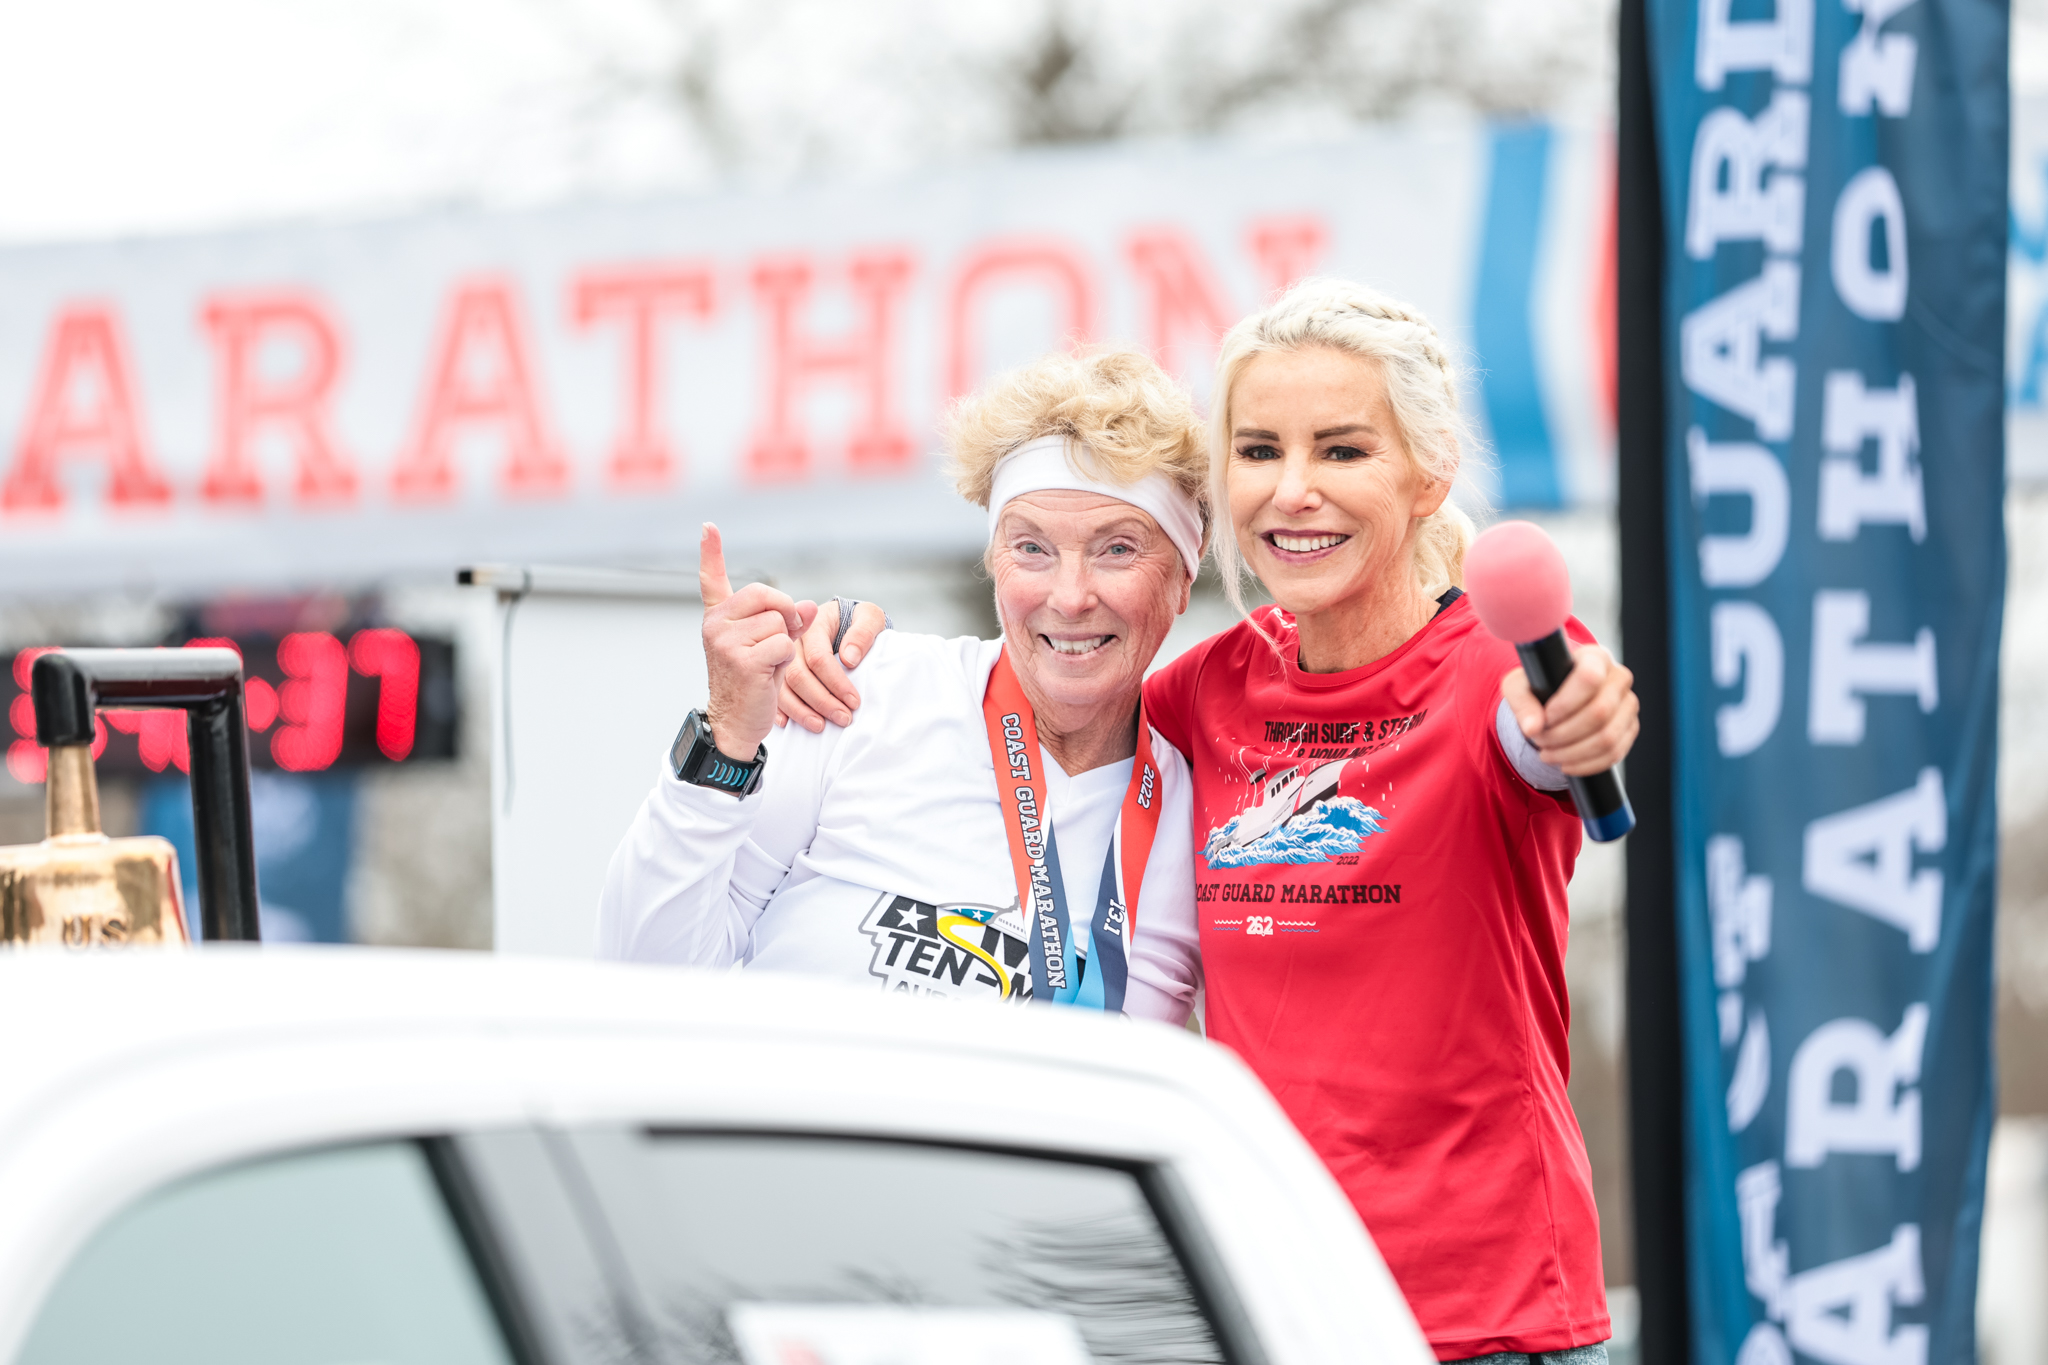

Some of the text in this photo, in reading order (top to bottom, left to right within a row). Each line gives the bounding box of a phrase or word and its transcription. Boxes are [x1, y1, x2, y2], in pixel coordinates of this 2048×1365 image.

[1264, 721, 1318, 744] THROUGH
[1321, 722, 1359, 744] SURF
[1362, 721, 1375, 742] &
[1137, 762, 1155, 809] 2022
[1001, 713, 1067, 989] COAST GUARD MARATHON
[1336, 856, 1360, 865] 2022
[1196, 883, 1402, 904] OAST GUARD MARATHON
[1103, 898, 1126, 936] 13.1
[1246, 915, 1274, 937] 26.2
